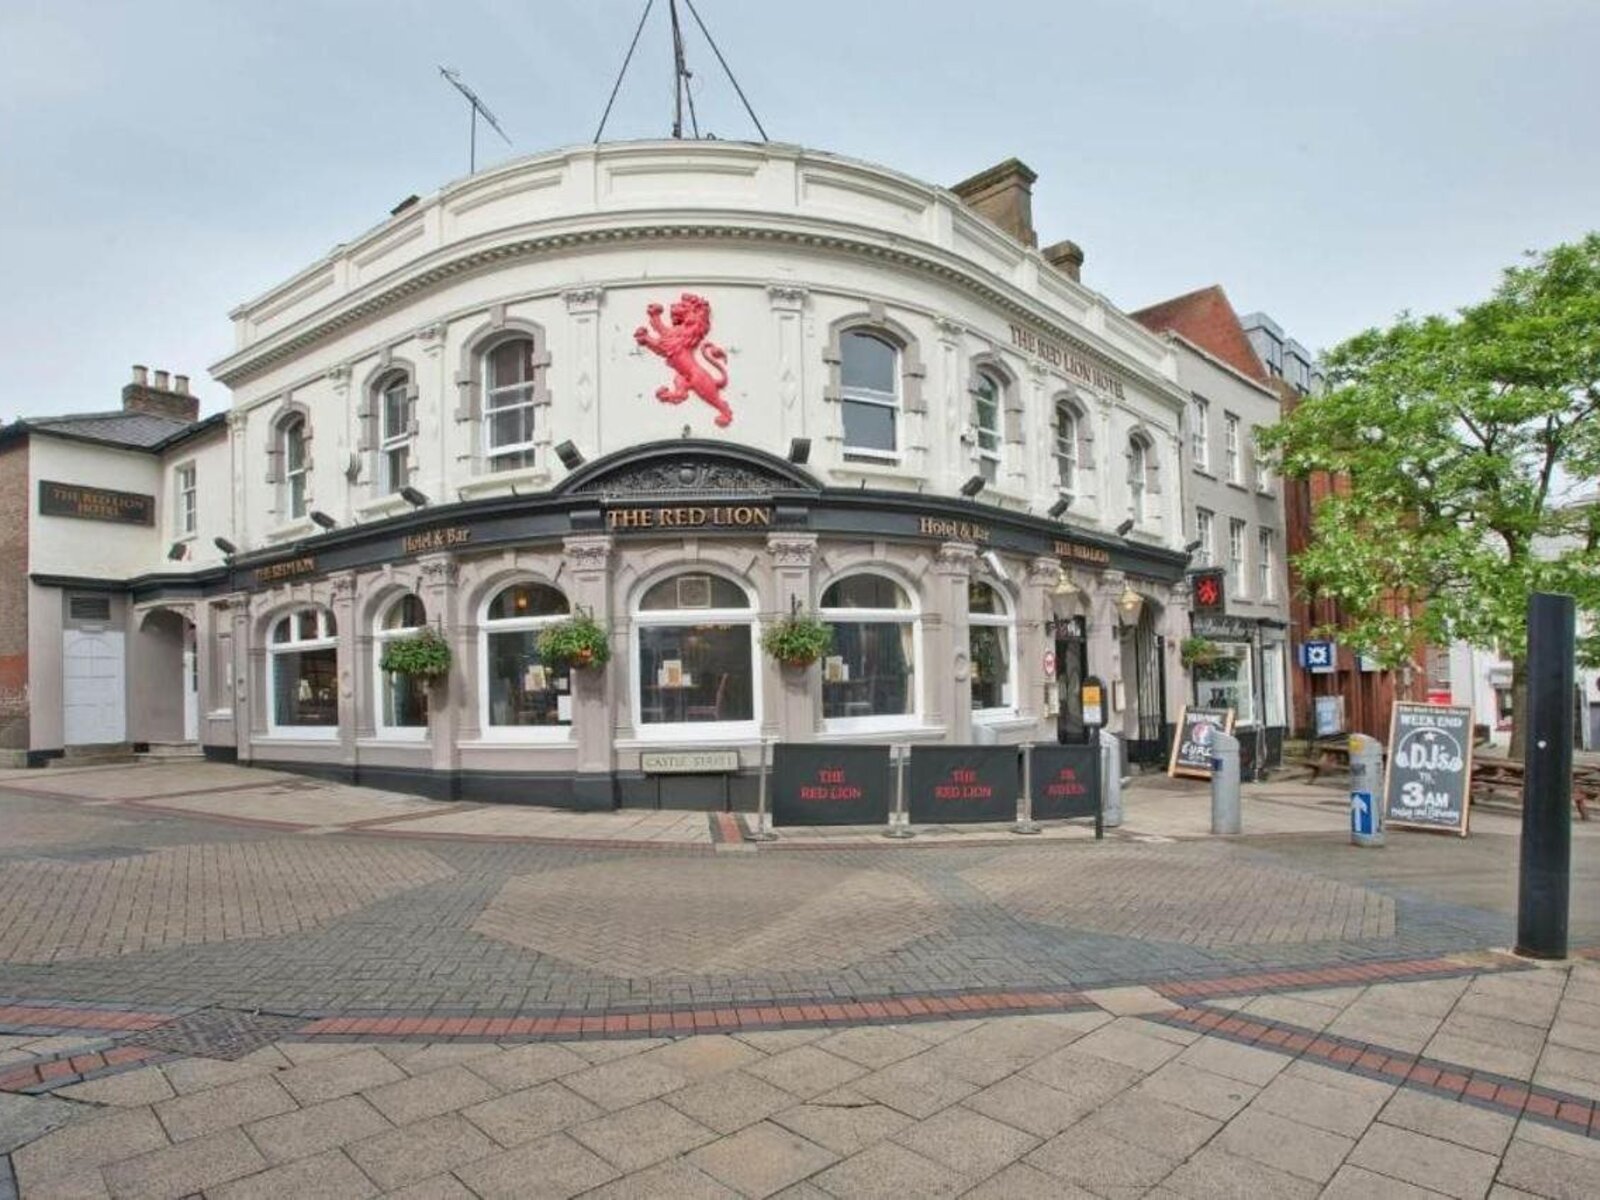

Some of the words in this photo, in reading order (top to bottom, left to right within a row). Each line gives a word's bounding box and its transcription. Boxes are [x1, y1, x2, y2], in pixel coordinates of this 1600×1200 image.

[1009, 324, 1036, 354] THE
[1038, 338, 1062, 367] RED
[1064, 352, 1091, 382] LION
[608, 509, 653, 528] THE
[659, 507, 706, 526] RED
[713, 506, 770, 525] LION
[446, 526, 472, 543] Bar
[920, 516, 957, 536] Hotel
[1400, 714, 1436, 727] WEEK
[1437, 716, 1463, 728] END
[1410, 742, 1450, 771] DJ's
[819, 769, 845, 784] THE
[952, 768, 977, 784] THE
[800, 786, 828, 800] RED
[830, 786, 861, 800] LION
[934, 785, 960, 799] RED
[962, 785, 992, 799] LION
[1401, 781, 1425, 808] 3
[1424, 791, 1449, 809] AM
